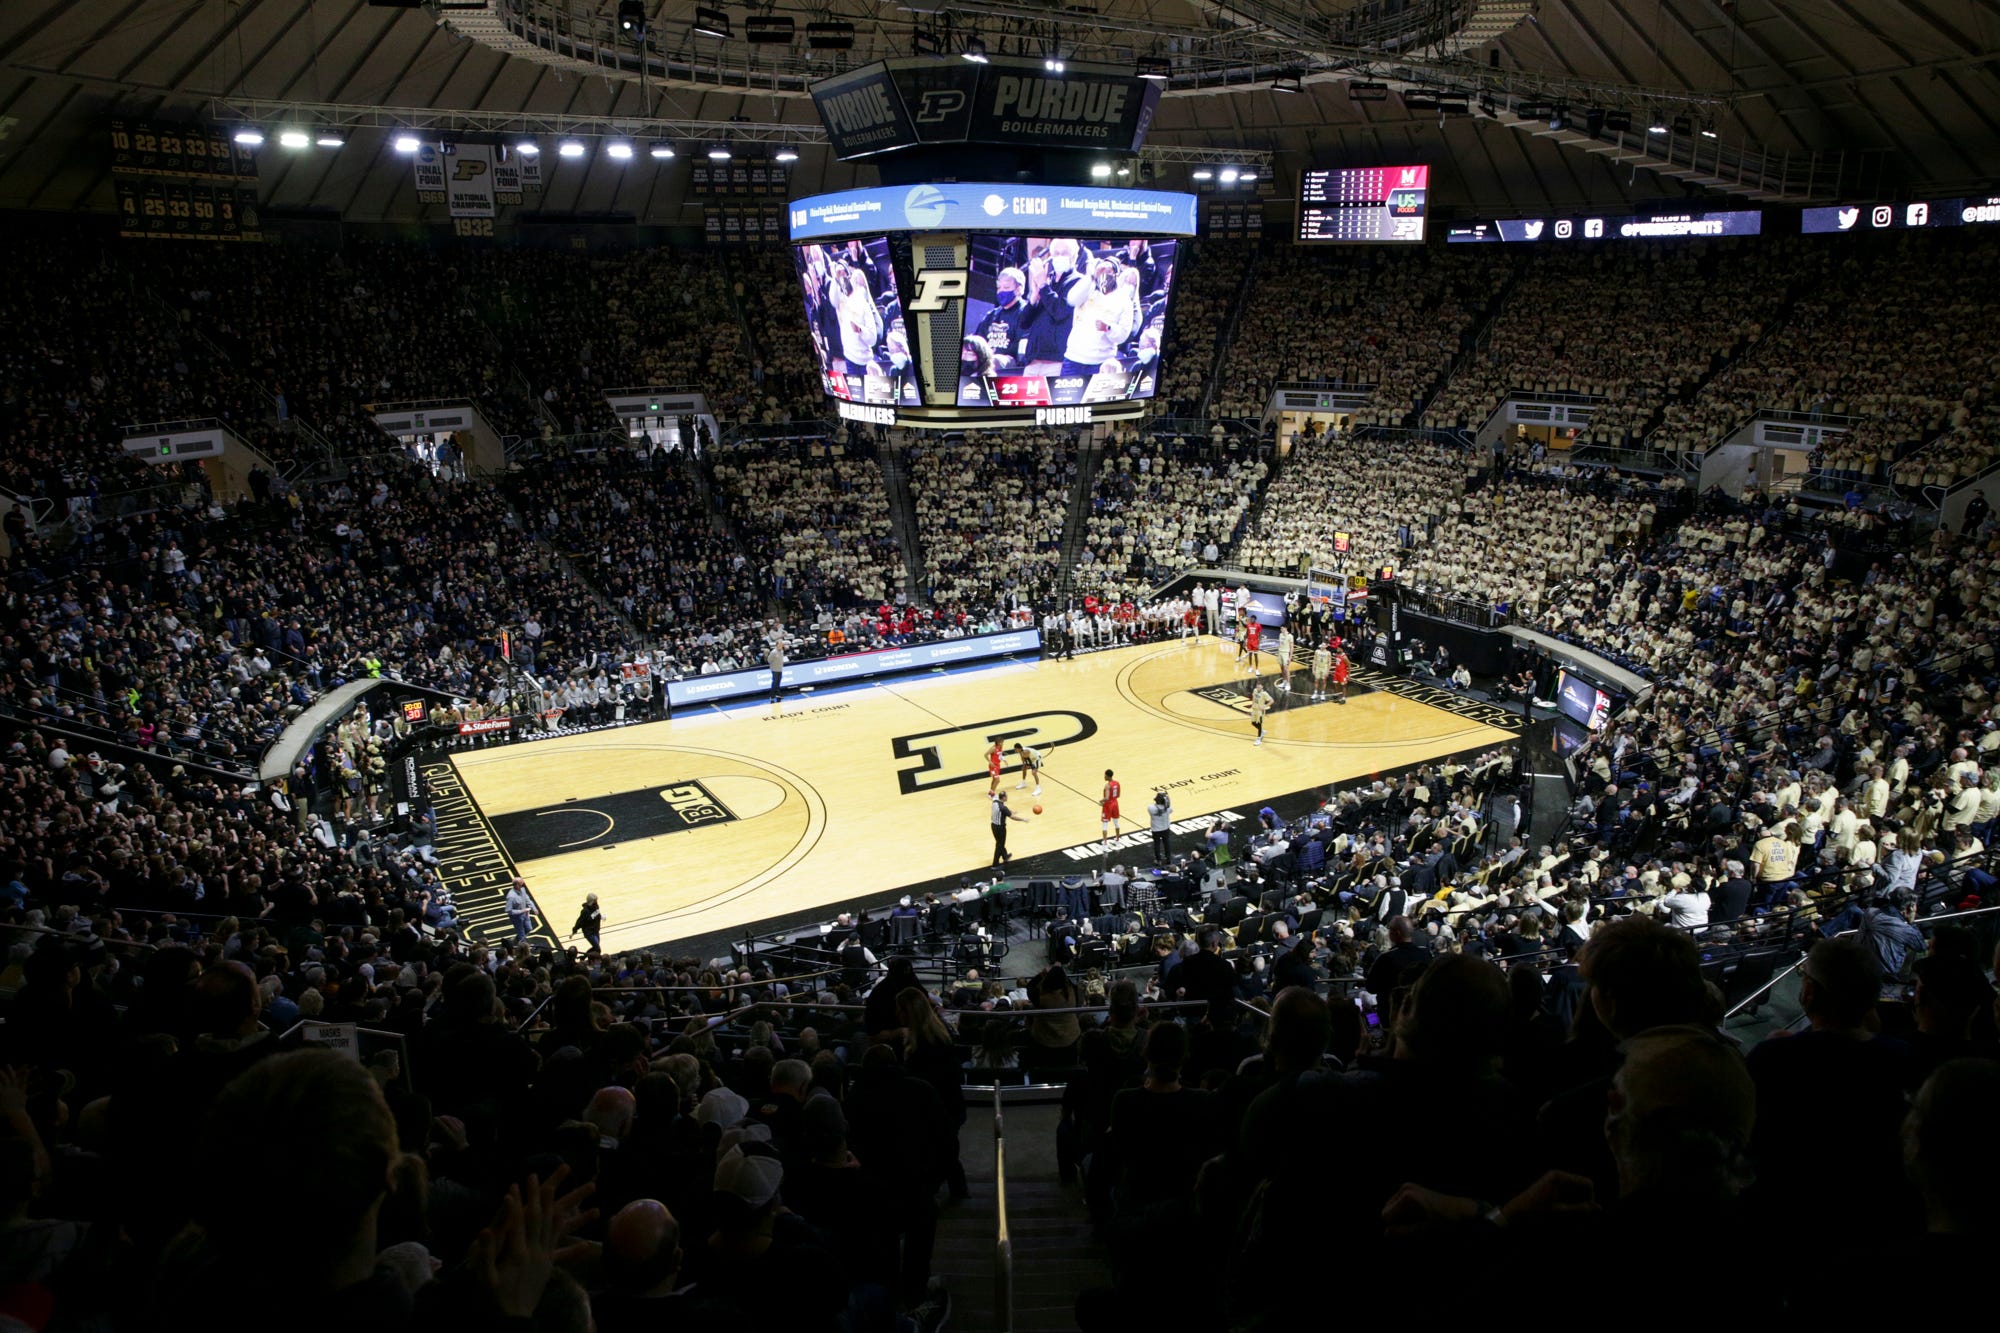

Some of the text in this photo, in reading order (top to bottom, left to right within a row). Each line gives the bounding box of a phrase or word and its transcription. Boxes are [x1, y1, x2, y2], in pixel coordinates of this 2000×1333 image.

[916, 90, 965, 123] P
[992, 75, 1128, 123] PURDUE
[823, 82, 896, 135] PURDUE
[843, 126, 896, 148] BOILERMAKERS
[1001, 121, 1109, 137] BOILERMAKERS
[112, 132, 129, 149] 10
[134, 135, 157, 152] 22
[160, 137, 182, 154] 23
[185, 139, 207, 156] 33
[210, 142, 230, 158] 55
[416, 166, 442, 175] FINAL
[452, 160, 487, 180] P
[494, 168, 519, 177] FINAL
[524, 166, 538, 174] NIT
[420, 176, 442, 184] FOUR
[497, 178, 518, 186] FOUR
[123, 197, 135, 214] 4
[418, 191, 446, 204] 1969
[454, 194, 487, 202] NATIONAL
[144, 199, 166, 215] 25
[169, 201, 190, 217] 33
[194, 202, 214, 218] 50
[222, 203, 233, 219] 3
[452, 202, 491, 210] CHAMPIONS
[1013, 198, 1047, 214] GEMCO
[454, 218, 494, 237] 1932
[909, 268, 967, 311] P
[1002, 384, 1018, 394] 23
[1054, 378, 1084, 388] 20:00
[1036, 407, 1092, 426] PURDUE
[939, 646, 972, 656] HONDA
[823, 662, 859, 673] HONDA
[696, 680, 736, 693] HONDA
[404, 702, 422, 711] 20:00
[762, 711, 804, 722] KEADY
[812, 704, 850, 714] COURT
[408, 710, 420, 720] 30
[472, 720, 510, 731] StateFarm
[891, 710, 1098, 795] P
[1151, 769, 1242, 793] KEADY COURT
[1169, 810, 1246, 836] ARENA
